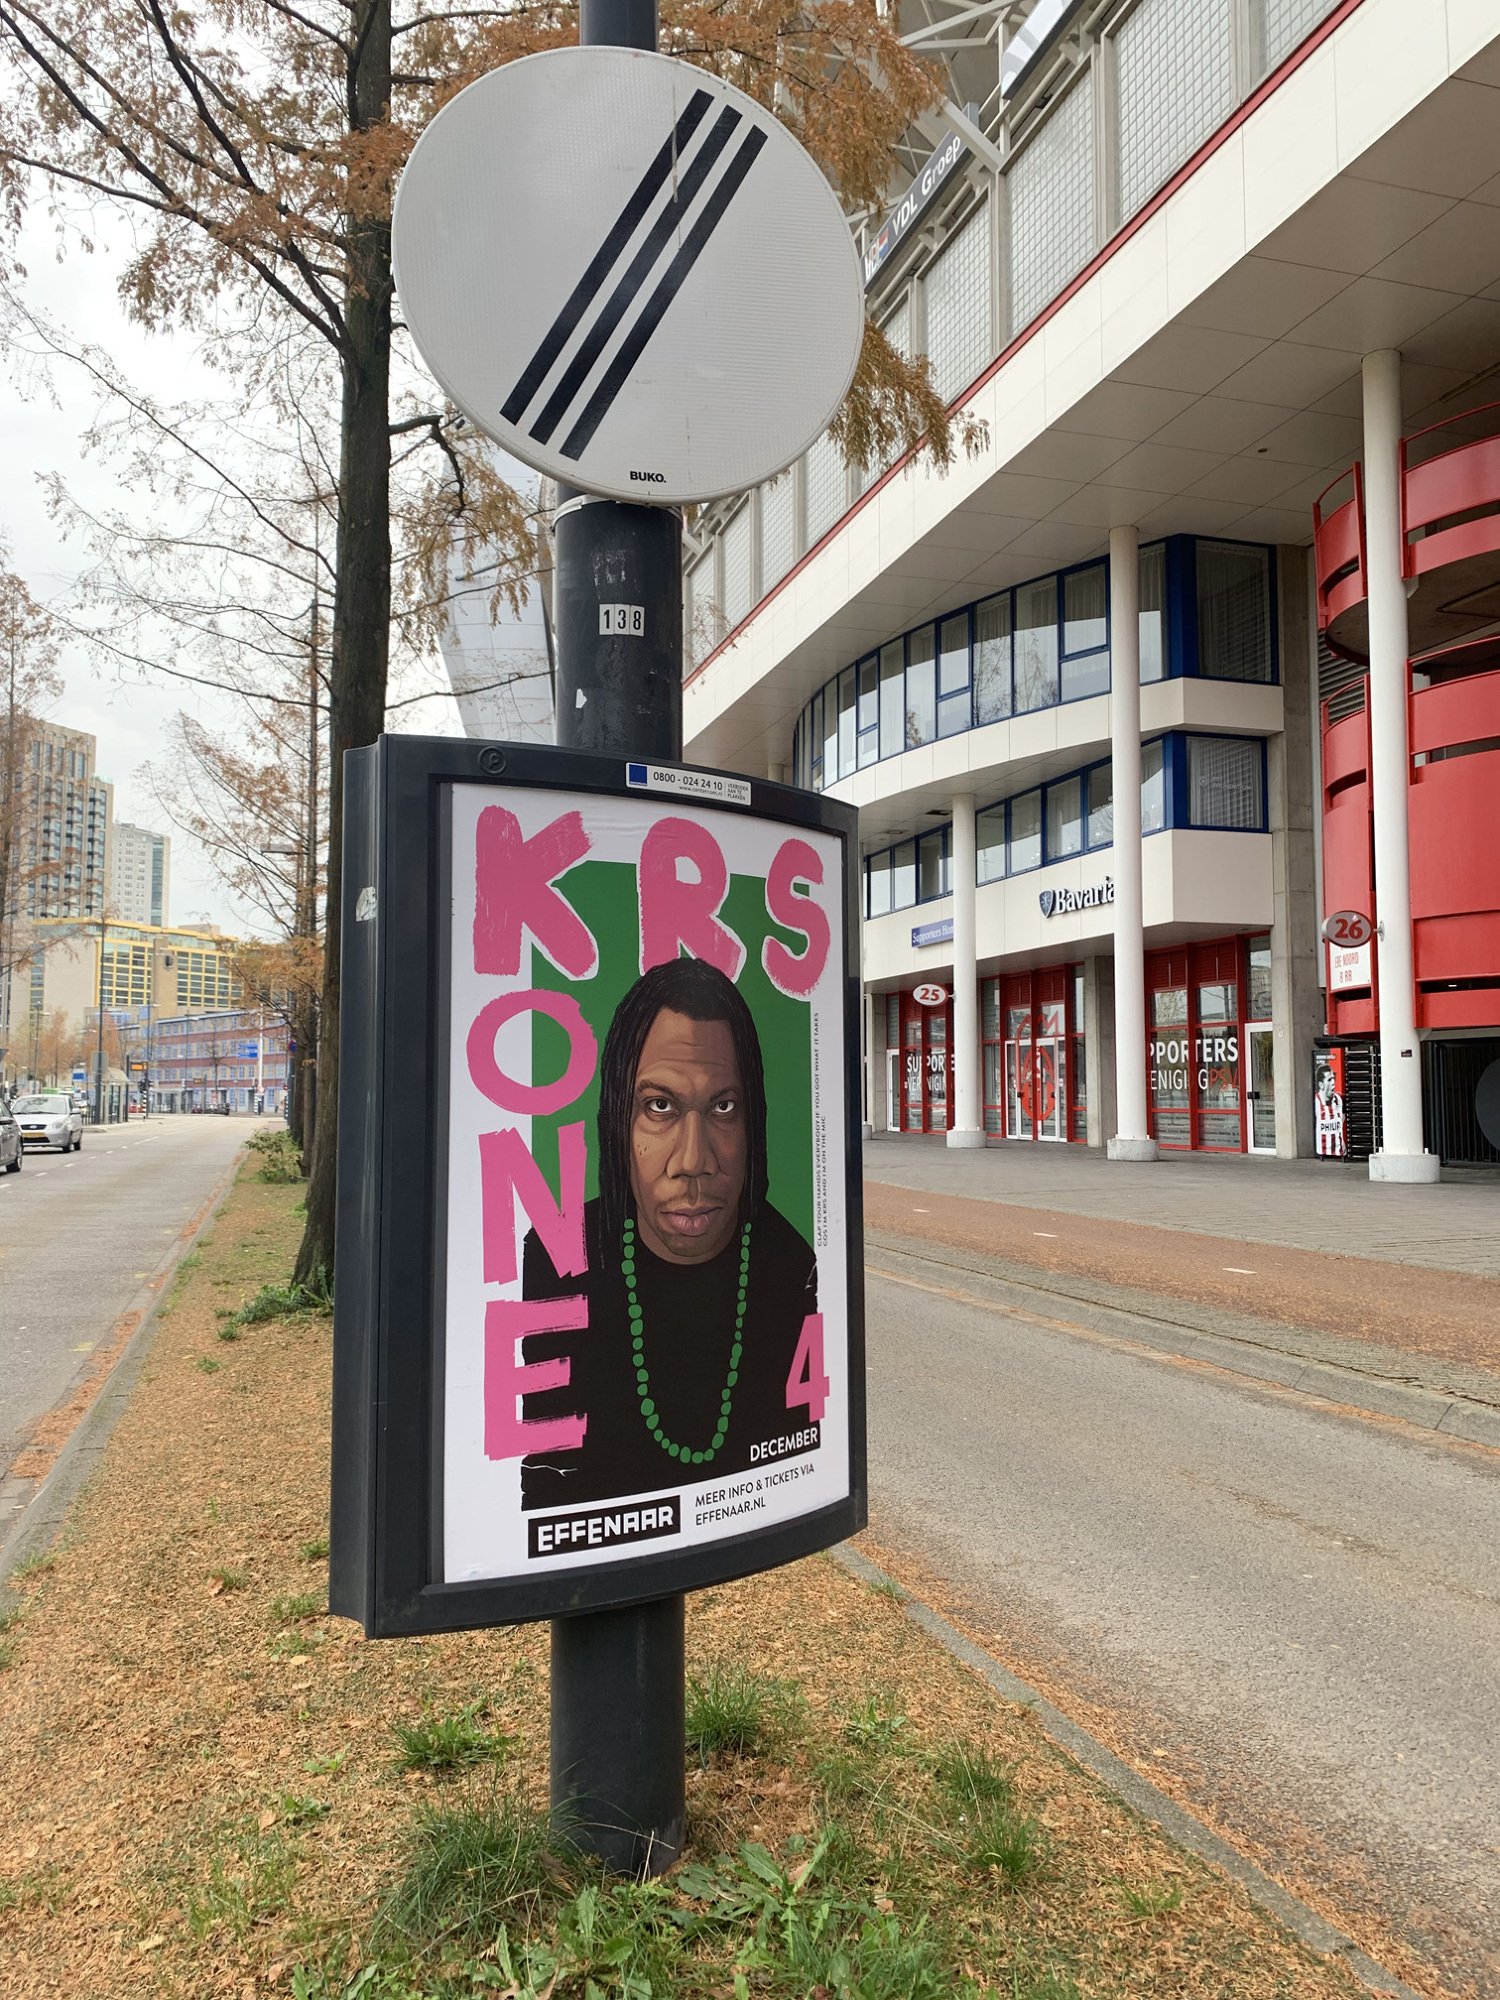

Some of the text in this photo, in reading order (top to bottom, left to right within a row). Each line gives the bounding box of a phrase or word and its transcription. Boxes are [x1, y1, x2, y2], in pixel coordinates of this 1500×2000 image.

[892, 136, 961, 236] VDL Groep
[630, 471, 667, 483] BUKO.
[603, 609, 641, 630] 138
[653, 771, 676, 783] 0800
[682, 776, 699, 786] 024
[701, 779, 711, 788] 24
[713, 782, 723, 791] 10
[473, 804, 831, 996] KRS
[912, 928, 942, 943] Supporters
[1334, 918, 1363, 939] 26
[920, 987, 940, 1001] 25
[821, 1150, 826, 1164] ON
[466, 989, 598, 1461] ONE
[785, 1313, 830, 1424] 4
[750, 1427, 818, 1462] DECEMBER
[695, 1463, 815, 1507] MEER INFO & TICKETS VIA
[695, 1496, 766, 1526] EFFENAAR.NL
[537, 1505, 674, 1552] EFFENAAR
